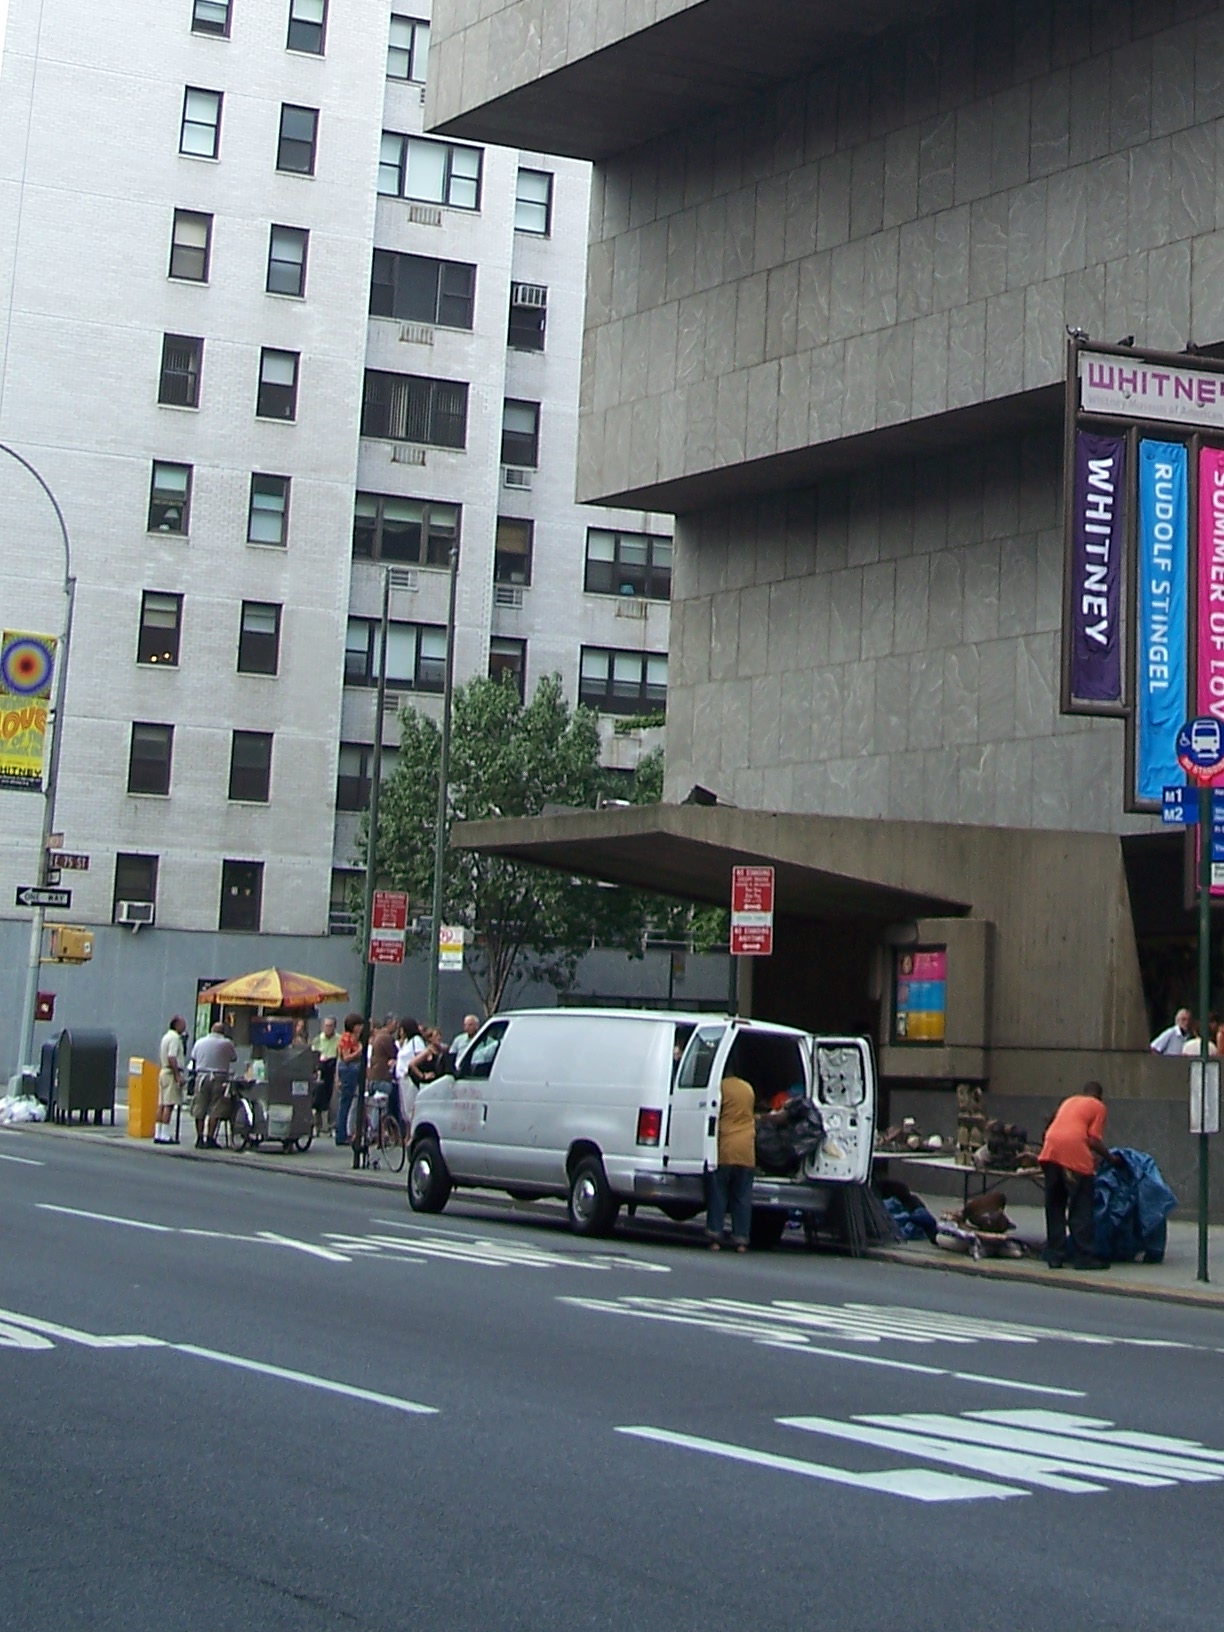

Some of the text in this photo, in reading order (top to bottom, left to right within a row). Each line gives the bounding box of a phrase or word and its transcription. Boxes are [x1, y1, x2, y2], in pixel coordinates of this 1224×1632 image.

[1082, 457, 1114, 646] WHITNEY
[1149, 462, 1173, 694] RUDOLF STINGEL
[0, 706, 47, 740] OVE
[0, 764, 42, 779] HITNEY
[1165, 788, 1182, 803] M1
[1163, 807, 1183, 822] M2
[24, 891, 65, 902] ONE WAY
